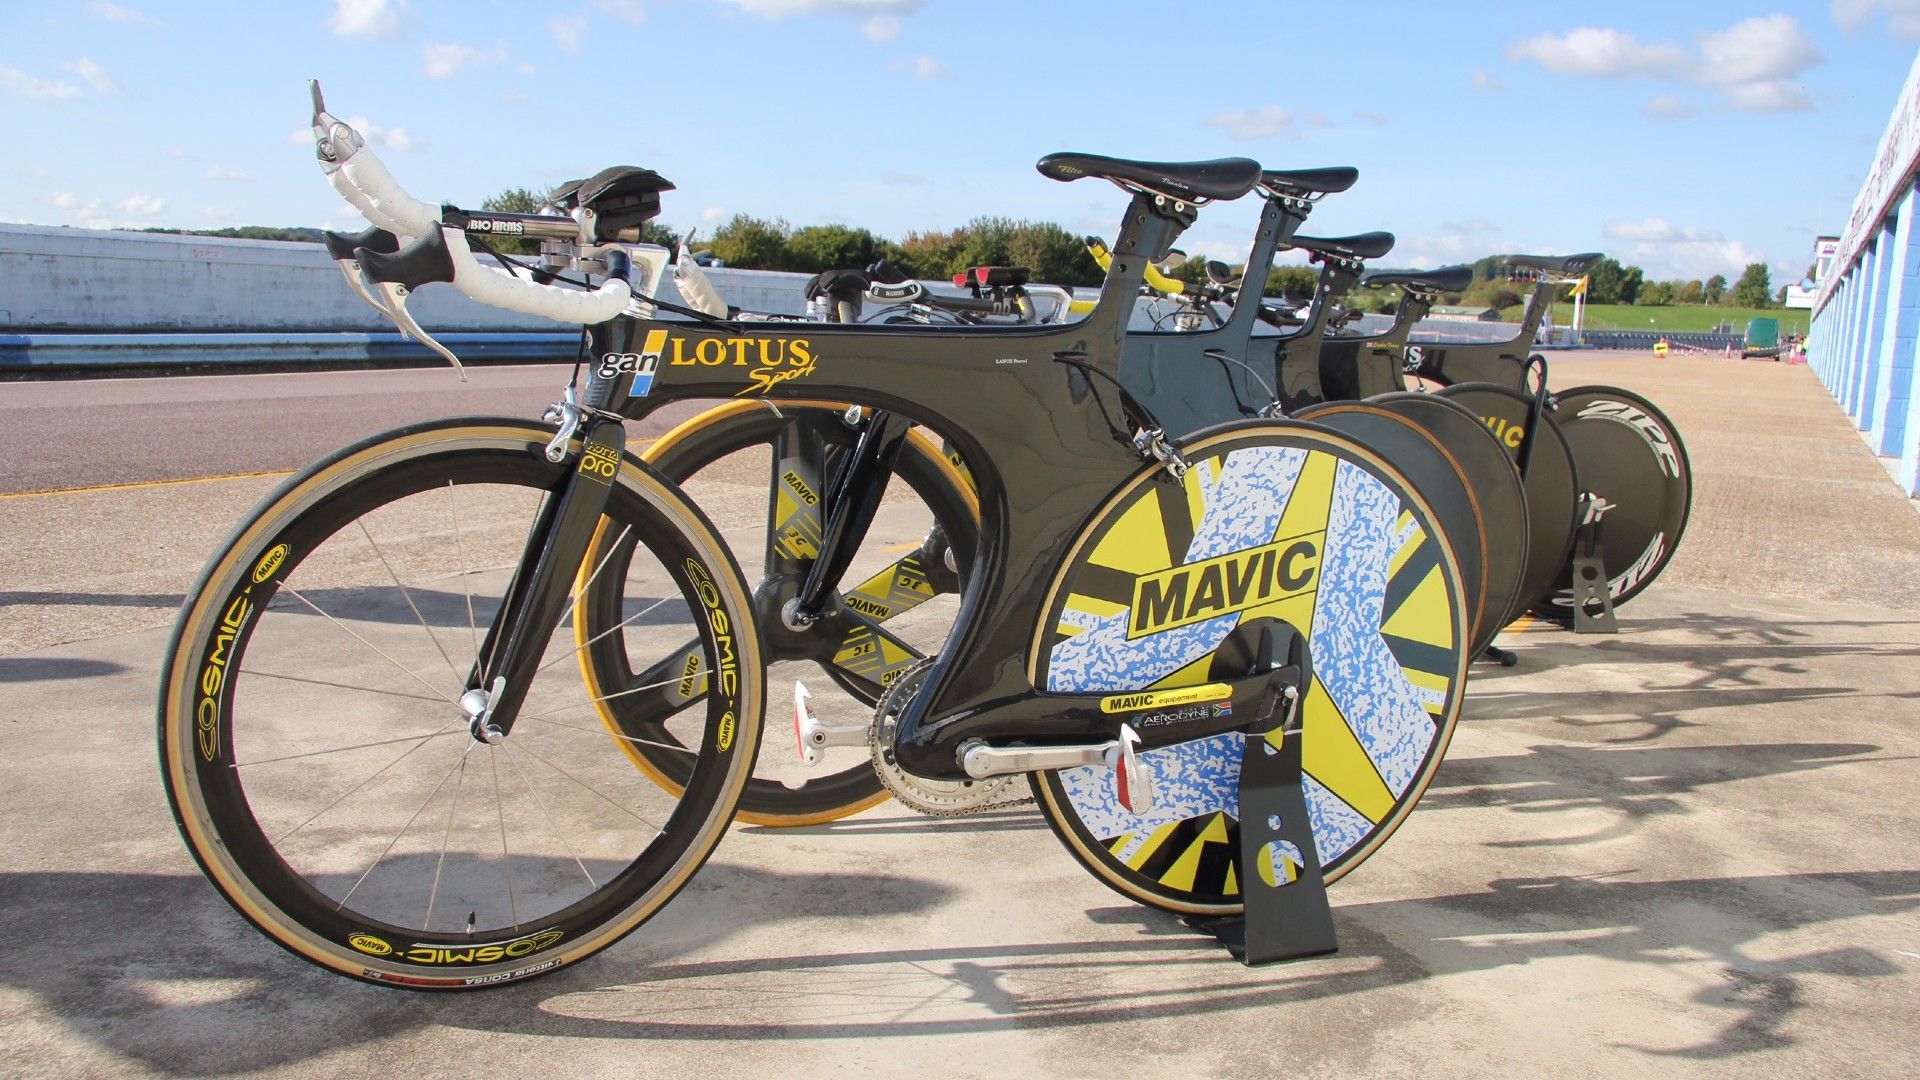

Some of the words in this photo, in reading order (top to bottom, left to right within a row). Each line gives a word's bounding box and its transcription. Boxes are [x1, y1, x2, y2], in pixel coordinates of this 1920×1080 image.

[470, 220, 492, 231] BIO
[492, 219, 524, 232] ARMS
[598, 352, 659, 379] gan
[671, 338, 810, 366] LOTUS
[734, 355, 819, 396] Sport
[578, 455, 615, 477] pro
[784, 473, 816, 504] MAVIC
[258, 550, 283, 578] MAVIC
[1136, 541, 1316, 631] MAVIC
[847, 597, 889, 617] MAVIC
[687, 558, 737, 697] COSMIC
[199, 595, 248, 762] COSMIC
[681, 656, 699, 696] MAVIC
[1110, 694, 1154, 710] MAVIC
[1144, 708, 1210, 724] AERODYNE
[721, 717, 731, 744] MAVIC
[357, 938, 385, 953] MAVIC
[407, 929, 564, 963] COSMIC
[465, 973, 511, 985] CORSA
